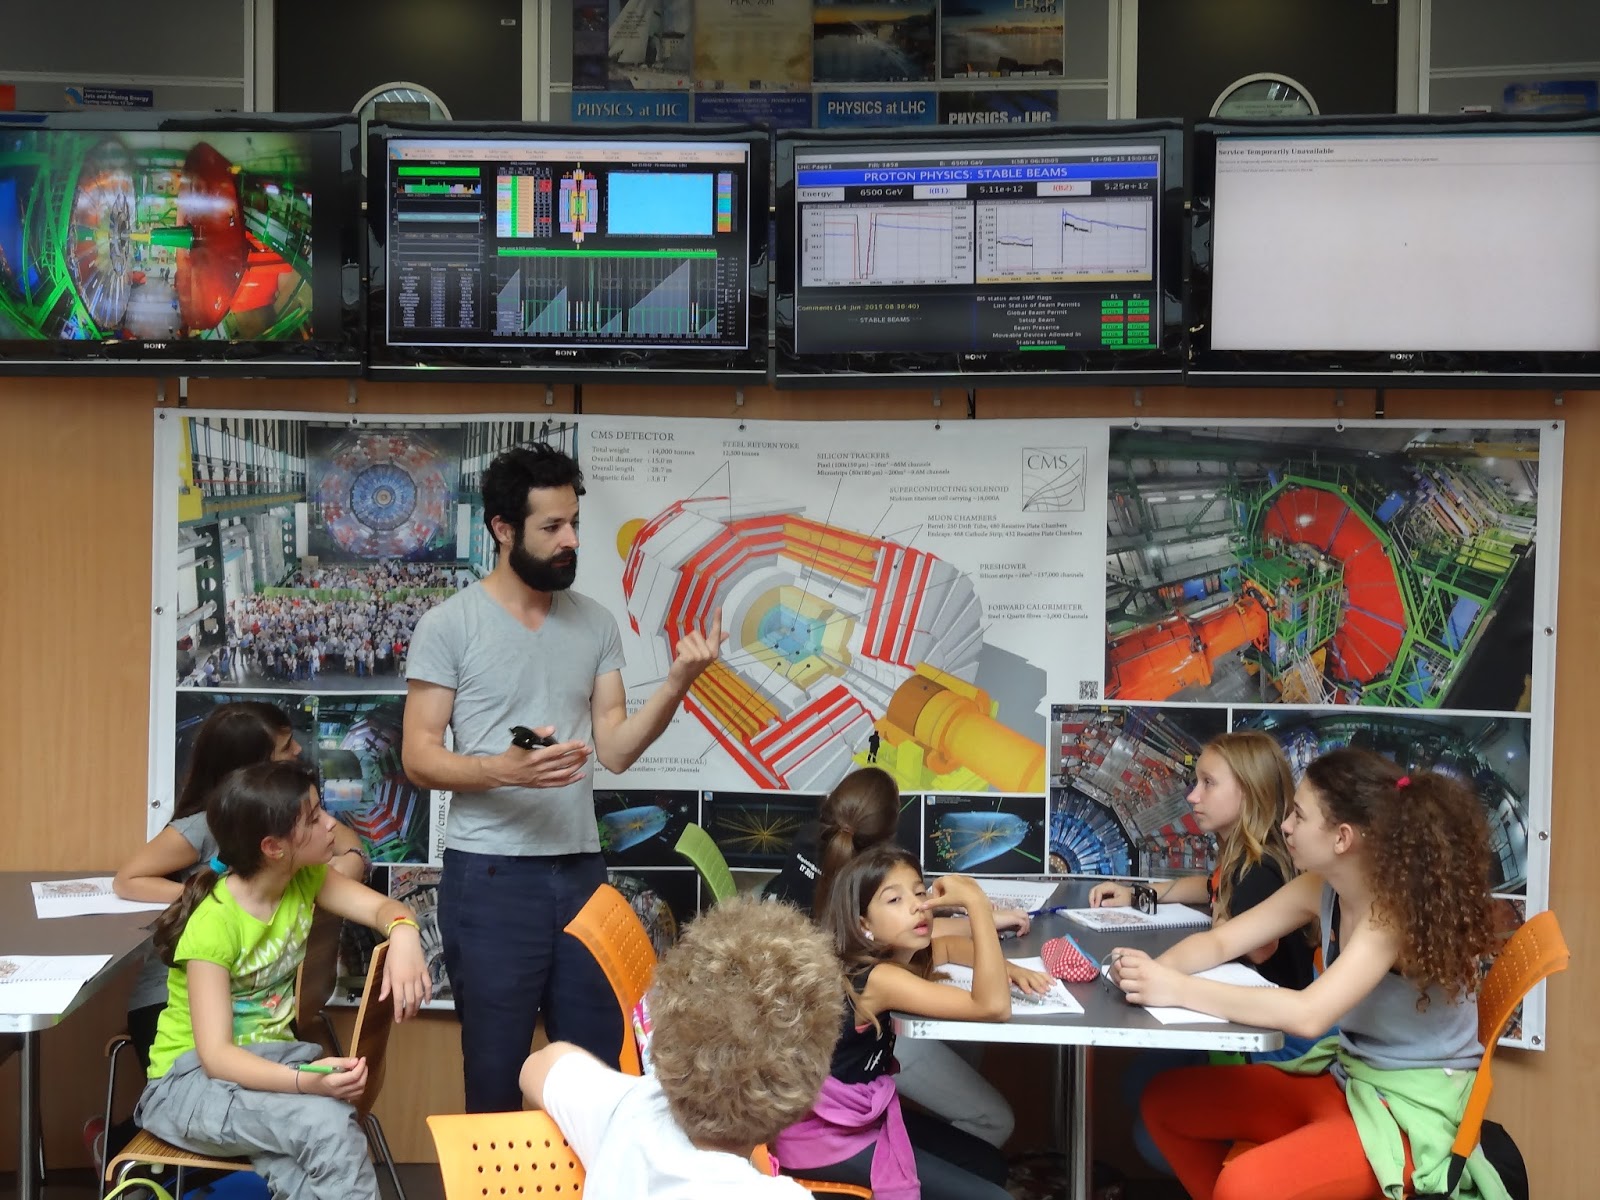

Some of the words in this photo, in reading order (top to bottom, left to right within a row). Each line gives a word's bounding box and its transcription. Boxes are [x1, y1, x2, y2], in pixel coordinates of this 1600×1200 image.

[1034, 5, 1057, 14] 2013
[578, 102, 634, 117] PHYSICS
[639, 105, 650, 117] at
[656, 103, 681, 117] LHC
[828, 101, 882, 115] PHYSICS
[886, 103, 897, 114] at
[900, 101, 926, 114] LHC
[948, 111, 1008, 125] PHYSICS
[1025, 111, 1051, 123] LHC
[1219, 148, 1245, 156] Service
[1247, 148, 1289, 157] Temporarily
[864, 172, 916, 182] PROTON
[920, 170, 973, 180] PHYSICS:
[978, 169, 1022, 179] STABLE
[1027, 168, 1068, 177] BEAMS
[980, 186, 1023, 194] 5.11e+12
[1104, 183, 1149, 191] 5.25e+12
[802, 191, 833, 199] Energy:
[860, 188, 883, 197] 6500
[885, 188, 903, 196] GeV
[834, 304, 847, 312] (14
[591, 430, 614, 440] CMS
[616, 431, 675, 441] DETECTOR
[747, 441, 778, 449] RETURN
[592, 446, 608, 454] Total
[608, 447, 630, 455] weight
[652, 448, 673, 456] 14,000
[1028, 454, 1068, 470] CMS
[614, 465, 635, 473] length
[592, 474, 620, 482] Magnetic
[890, 486, 968, 494] SUPERCONDUCTING
[680, 757, 707, 765] (HCAL)
